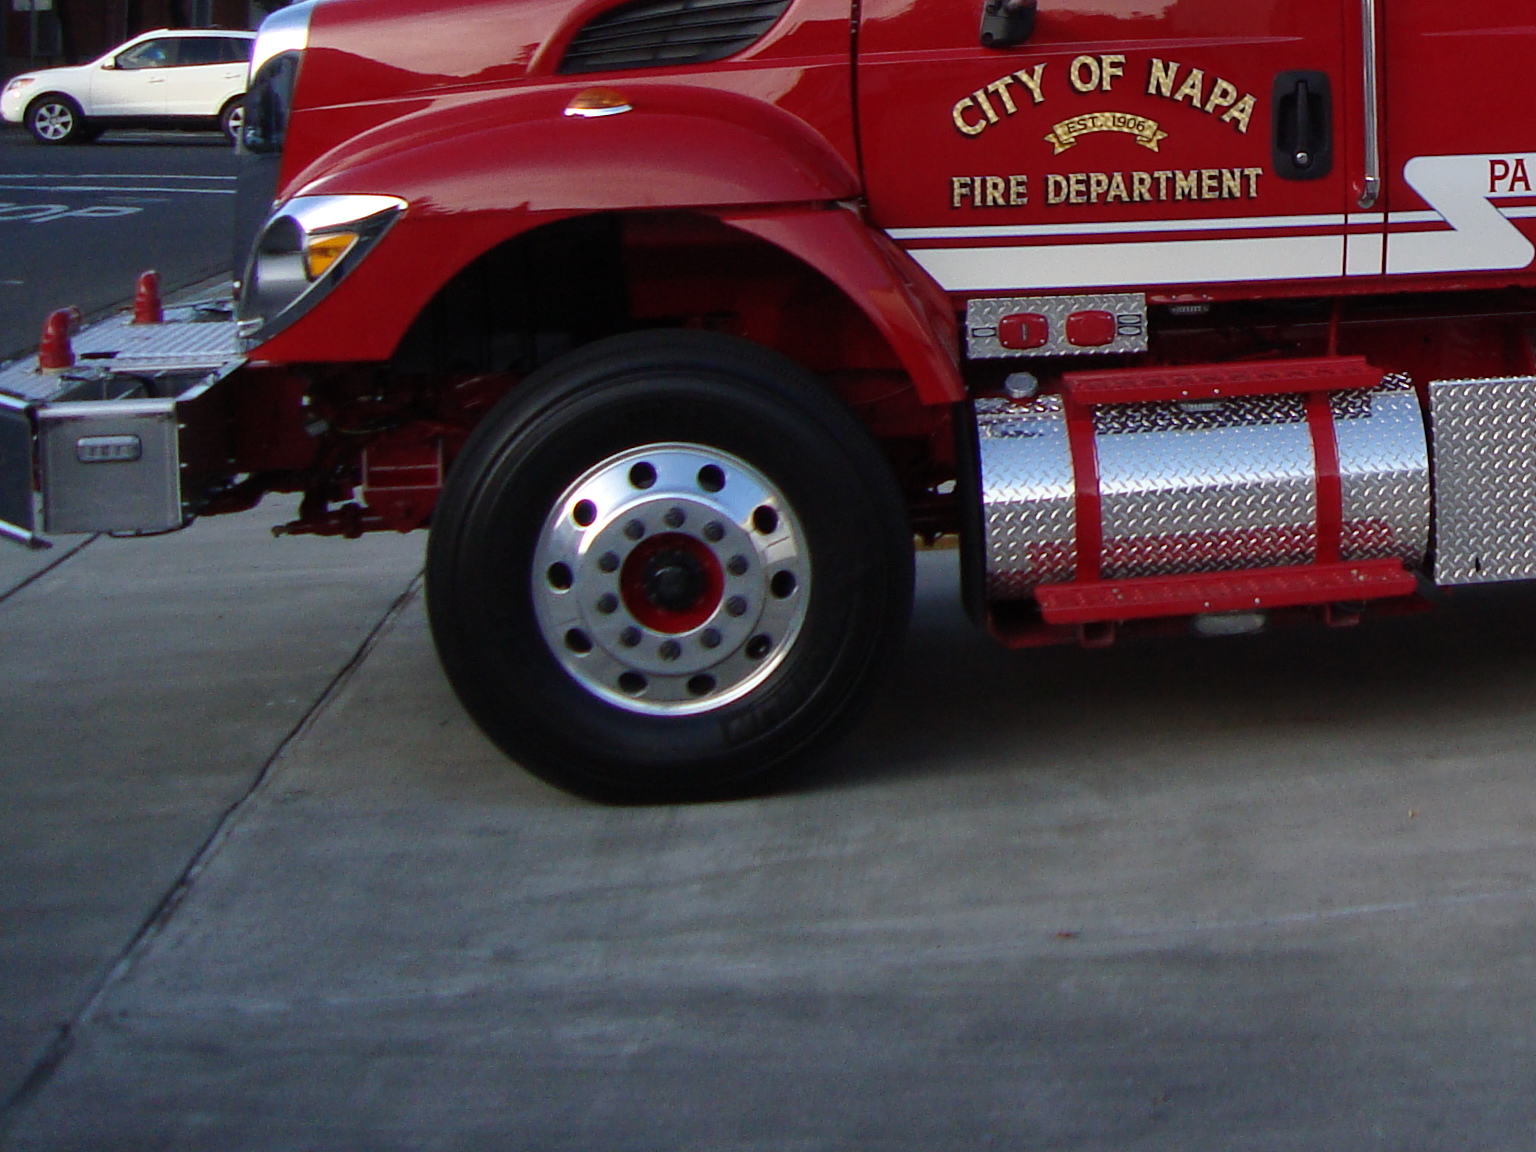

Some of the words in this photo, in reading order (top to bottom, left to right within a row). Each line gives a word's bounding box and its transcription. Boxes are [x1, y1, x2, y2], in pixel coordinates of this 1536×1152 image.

[952, 62, 1047, 136] CITY
[1070, 54, 1126, 92] OF
[1147, 57, 1258, 134] NAPA
[1066, 116, 1103, 134] EST.
[1112, 115, 1146, 133] 1906
[951, 174, 1029, 207] FIRE
[1046, 167, 1264, 205] DEPARTMENT
